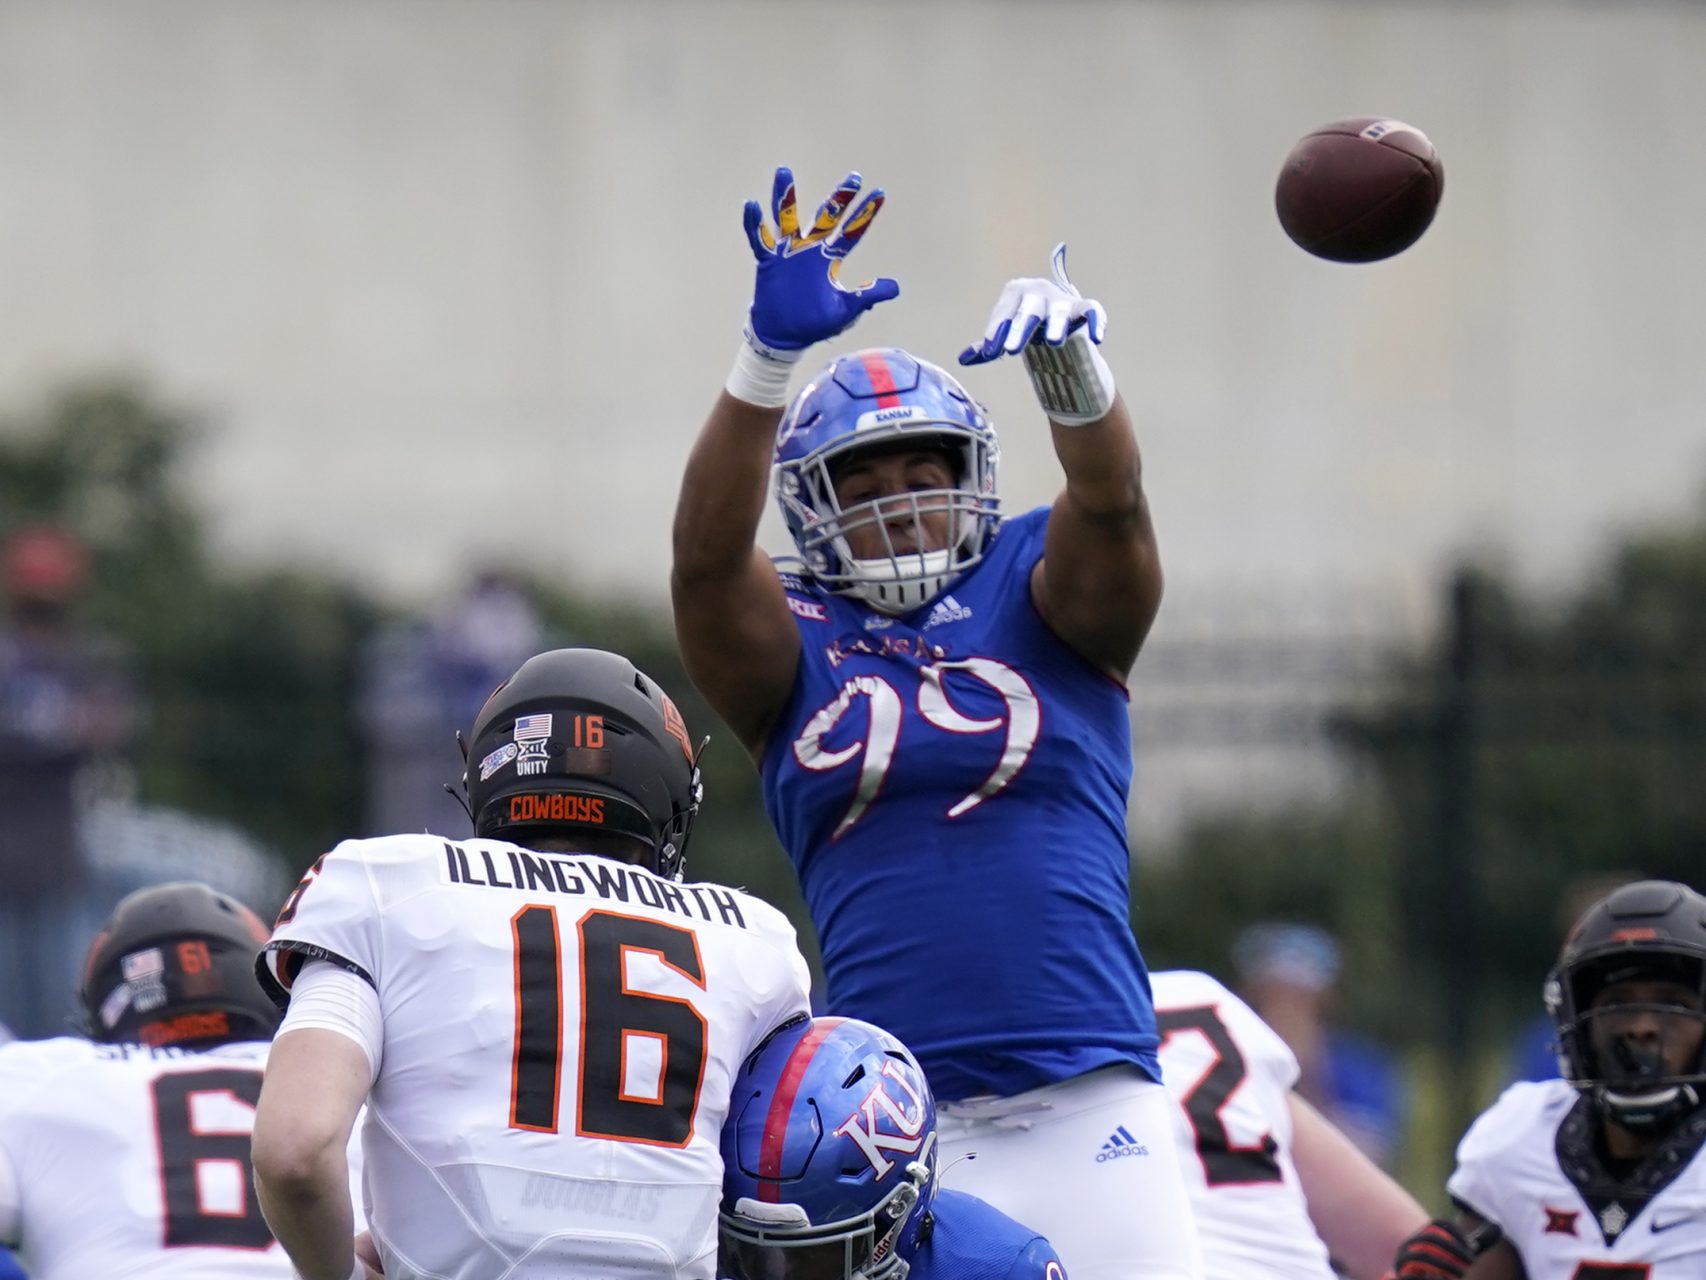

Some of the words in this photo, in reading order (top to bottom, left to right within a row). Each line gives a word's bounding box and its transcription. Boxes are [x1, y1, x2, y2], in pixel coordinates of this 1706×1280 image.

[574, 714, 604, 749] 16
[794, 653, 1042, 842] 99
[516, 760, 548, 776] UNITY
[510, 794, 605, 824] COWBOYS
[443, 843, 747, 930] ILLINGWORTH
[509, 903, 707, 1149] 16
[836, 1059, 924, 1182] KU
[1096, 1144, 1149, 1163] adidas
